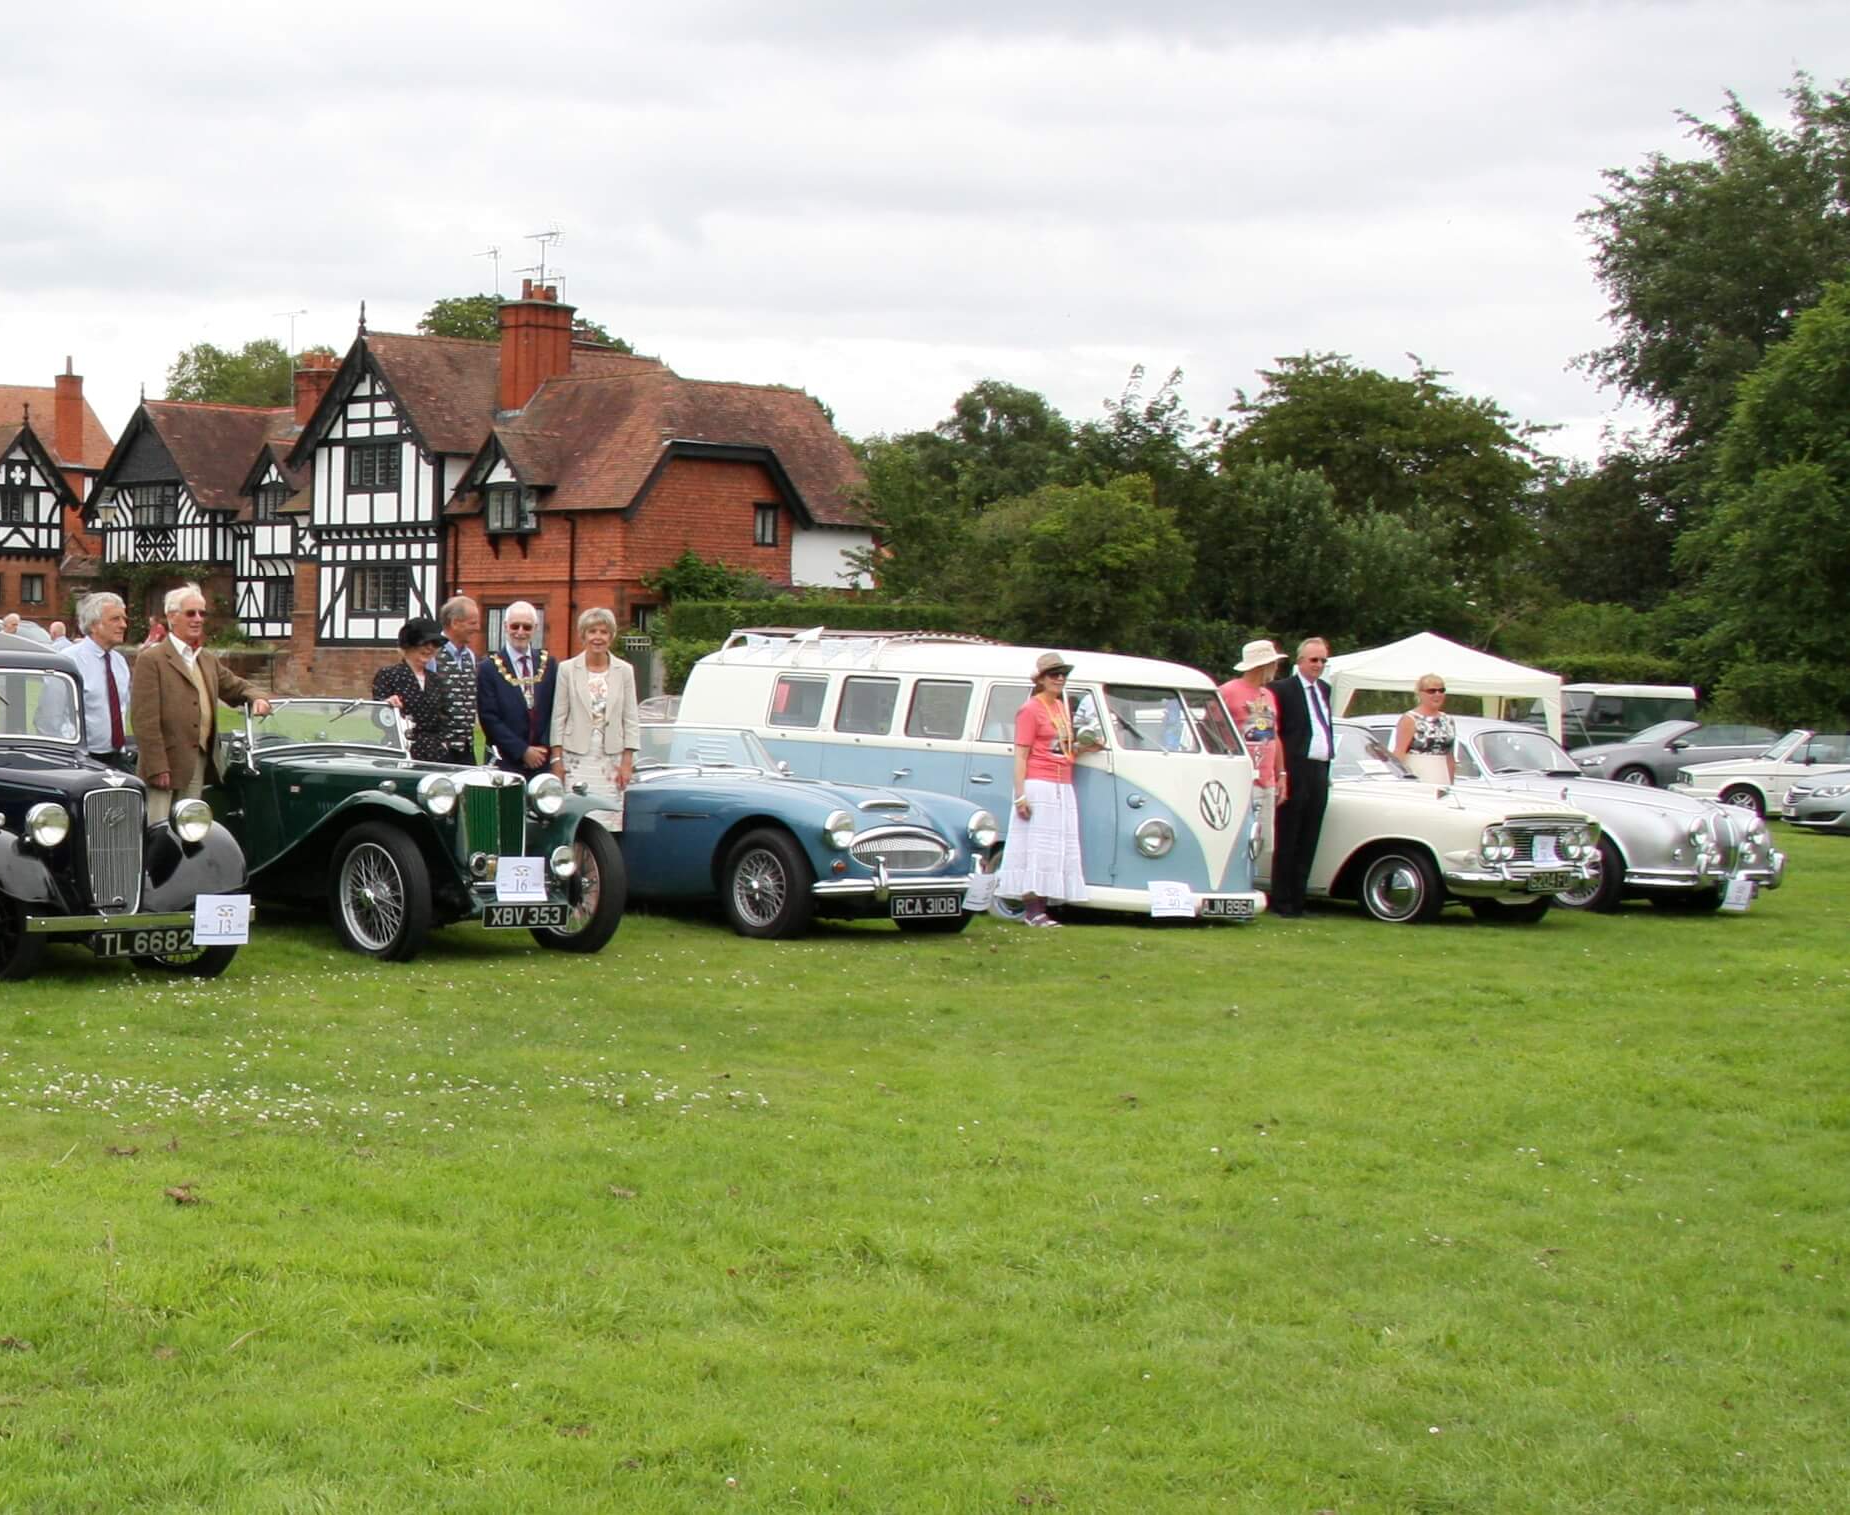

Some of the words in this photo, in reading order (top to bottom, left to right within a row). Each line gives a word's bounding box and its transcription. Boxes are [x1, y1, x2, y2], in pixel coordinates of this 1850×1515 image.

[516, 879, 527, 892] 16
[896, 898, 923, 915] RCA
[926, 897, 956, 914] 310B
[491, 907, 525, 926] XBV
[528, 906, 561, 925] 353
[218, 919, 232, 934] 13
[101, 933, 130, 956] TL
[133, 930, 193, 953] 6682
